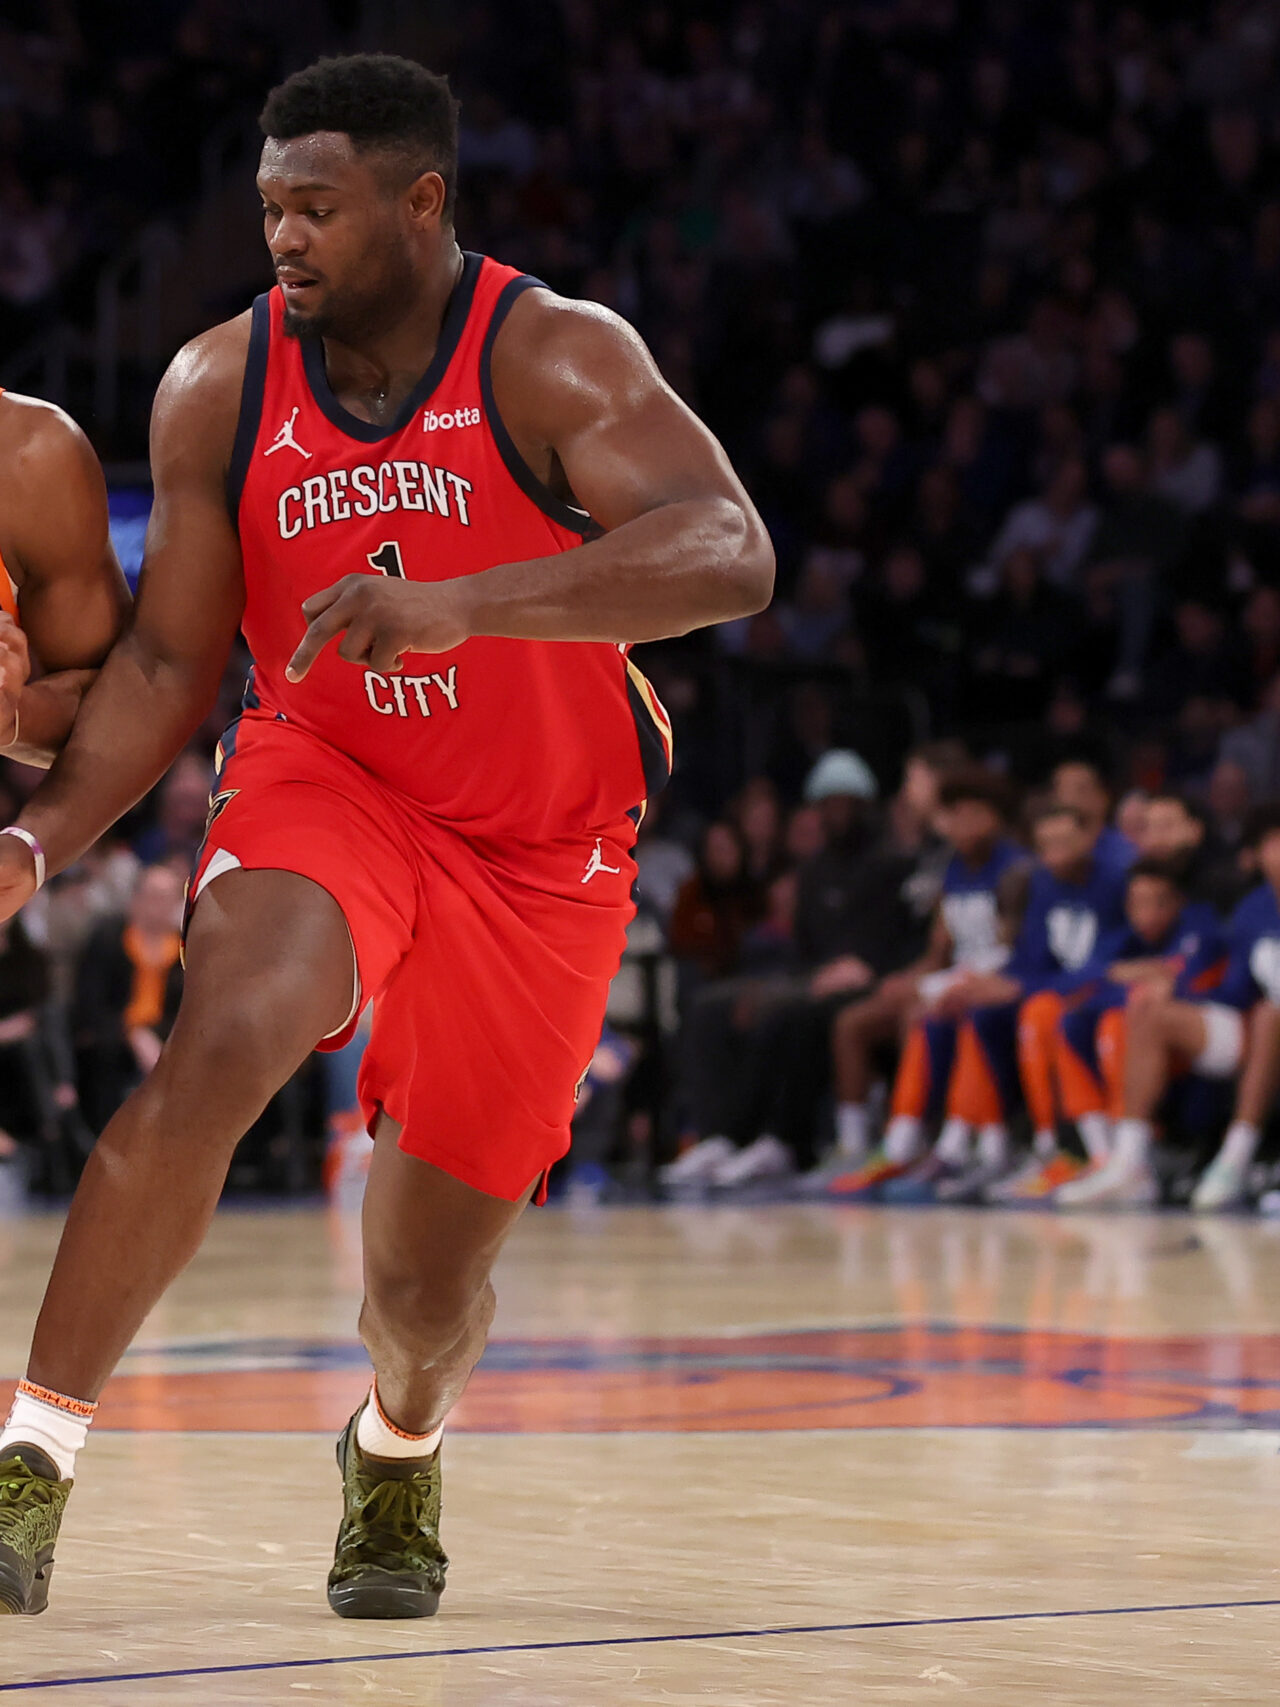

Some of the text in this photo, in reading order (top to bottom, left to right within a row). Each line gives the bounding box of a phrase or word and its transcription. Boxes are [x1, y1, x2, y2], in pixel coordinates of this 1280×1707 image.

[423, 407, 480, 432] ibotta
[277, 461, 472, 539] CRESCENT
[364, 665, 459, 717] CITY
